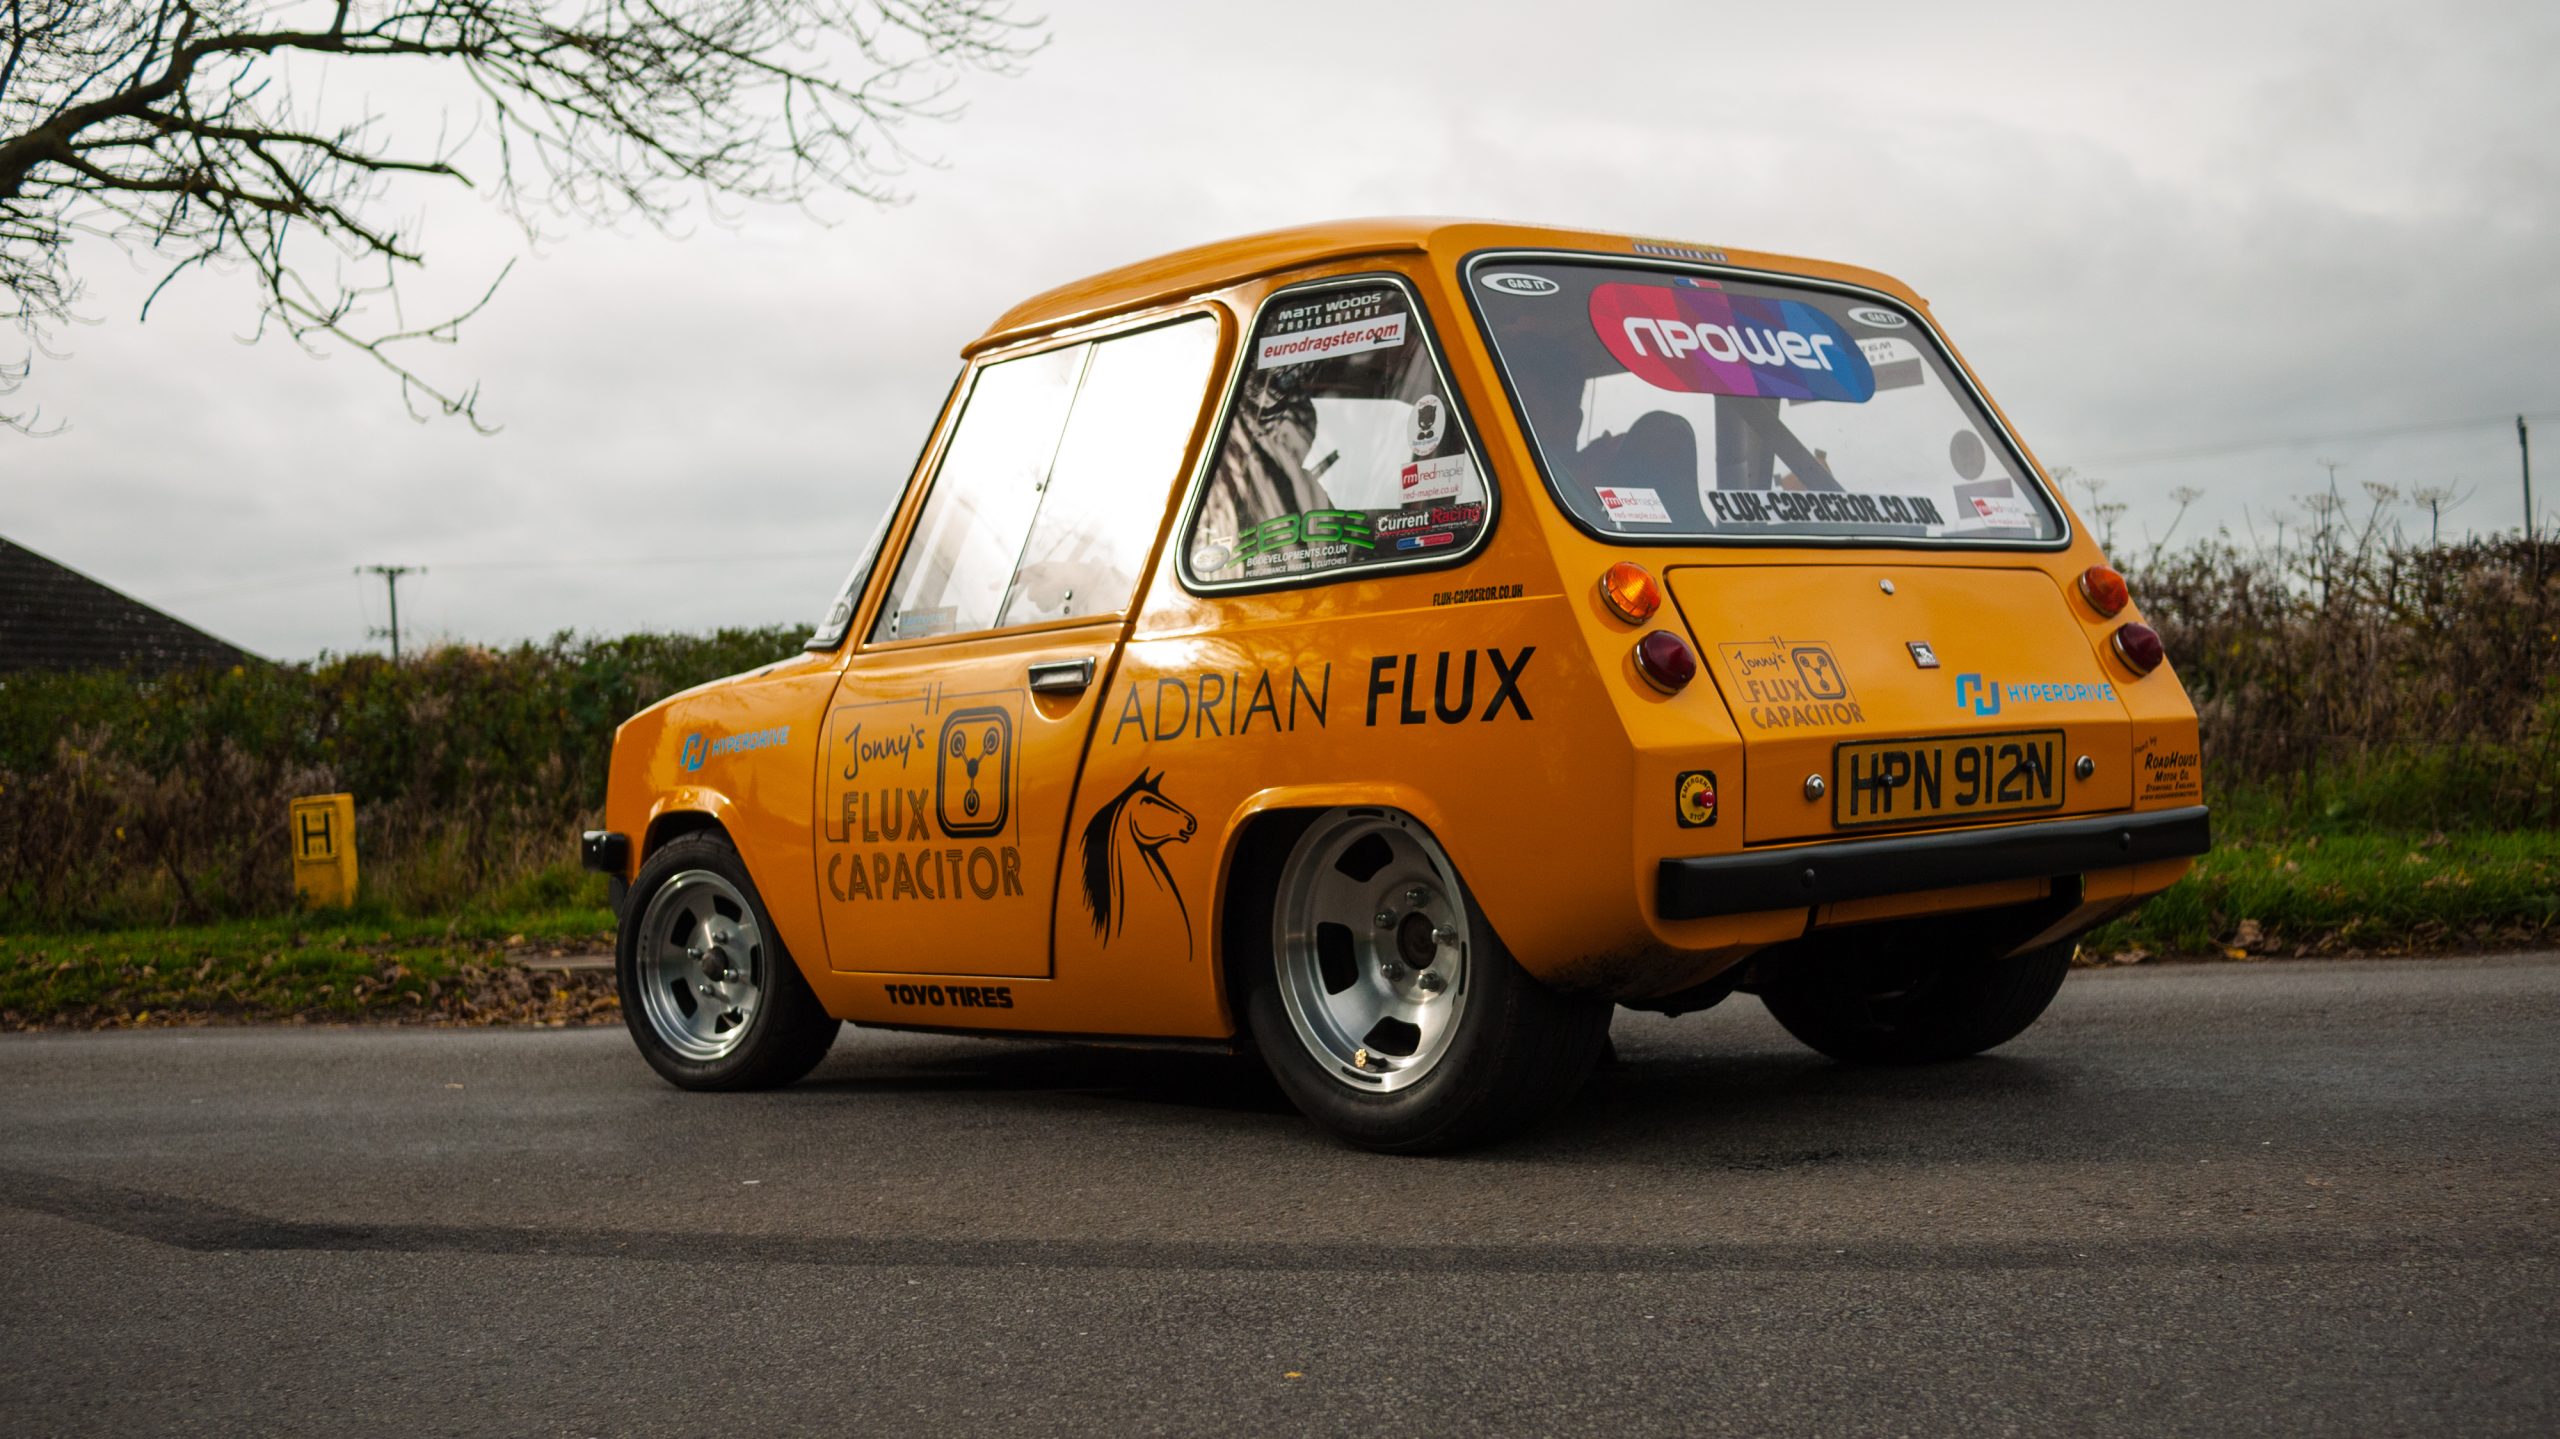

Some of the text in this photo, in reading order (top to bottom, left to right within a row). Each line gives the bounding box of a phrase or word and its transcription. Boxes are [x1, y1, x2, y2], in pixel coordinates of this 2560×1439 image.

[1507, 278, 1545, 290] GAS IT
[1326, 293, 1382, 312] WOODS
[1277, 305, 1381, 333] PHOTOGRAPHY
[1264, 323, 1399, 358] eurodragster.com
[1378, 512, 1429, 532] Current
[1431, 505, 1481, 523] Racing
[1733, 650, 1786, 676] Jonny's
[1111, 646, 1536, 744] ADRIAN FLUX
[1747, 679, 1808, 703] FLUX
[2006, 683, 2116, 702] HYPERDRIVE
[1750, 702, 1866, 729] CAPACITOR
[711, 726, 791, 757] HYPERDRIVE
[843, 723, 926, 780] Jonny's
[1681, 776, 1711, 799] EMERGENC
[1850, 741, 2053, 816] HPN 912N
[842, 788, 930, 844] FLUX
[1690, 812, 1706, 821] STOP
[302, 812, 331, 855] H
[827, 846, 1025, 902] CAPACITOR
[884, 983, 1014, 1009] TOYO TIRES
